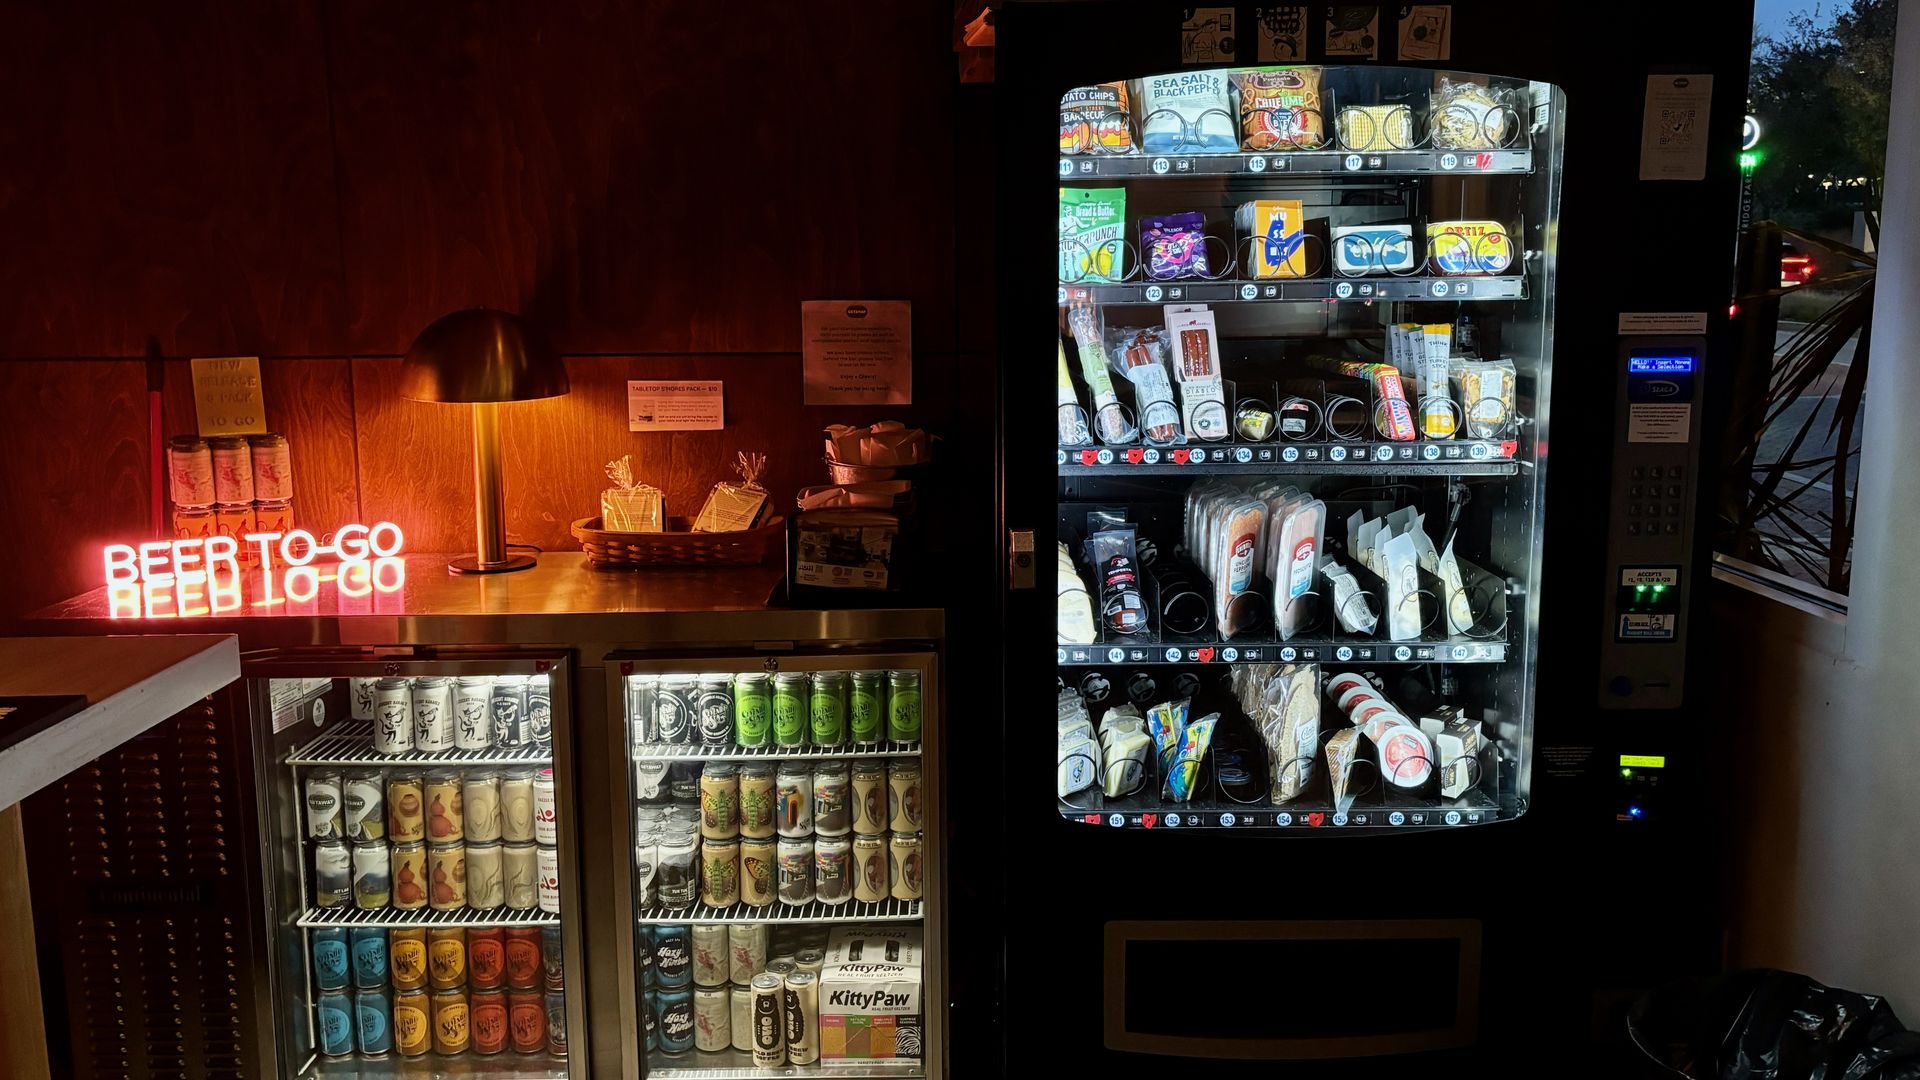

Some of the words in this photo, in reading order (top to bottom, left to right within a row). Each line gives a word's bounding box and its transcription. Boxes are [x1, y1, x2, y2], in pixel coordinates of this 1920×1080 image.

[1153, 78, 1177, 89] SEA
[1181, 74, 1211, 86] SALT
[1089, 91, 1116, 101] CHIPS
[1154, 87, 1186, 98] BLACK
[1153, 161, 1168, 171] 113
[1249, 159, 1264, 169] 115
[1346, 158, 1361, 168] 117
[1442, 156, 1456, 166] 119
[1146, 287, 1161, 298] 123
[1243, 286, 1257, 296] 125
[1338, 285, 1352, 295] 127
[1433, 283, 1447, 293] 129
[208, 360, 242, 370] NEW
[1186, 386, 1216, 395] DIABLO
[208, 415, 227, 427] TO
[234, 415, 256, 426] GO
[1099, 450, 1112, 461] 131
[1144, 450, 1158, 461] 132
[1190, 450, 1204, 461] 133
[1238, 450, 1251, 460] 134
[1284, 448, 1297, 459] 135
[1331, 448, 1345, 458] 136
[1378, 447, 1392, 458] 137
[1425, 446, 1439, 456] 138
[1471, 445, 1484, 456] 139
[104, 536, 238, 586] BEER
[244, 521, 404, 570] TO-GO
[1109, 651, 1123, 661] 141
[1167, 650, 1181, 660] 142
[1223, 649, 1237, 659] 143
[1281, 648, 1295, 659] 144
[1338, 648, 1352, 658] 145
[1396, 647, 1410, 657] 146
[1453, 646, 1467, 657] 147
[1111, 815, 1124, 826] 151
[1166, 814, 1180, 825] 152
[1222, 814, 1234, 825] 153
[1278, 814, 1291, 824] 154
[1390, 813, 1403, 823] 156
[1446, 812, 1460, 822] 157
[657, 946, 682, 959] Hazy
[659, 956, 690, 968] Nimbus
[839, 963, 905, 973] KittyPaw
[829, 990, 910, 1010] KittyPaw
[663, 1012, 689, 1024] Hazy
